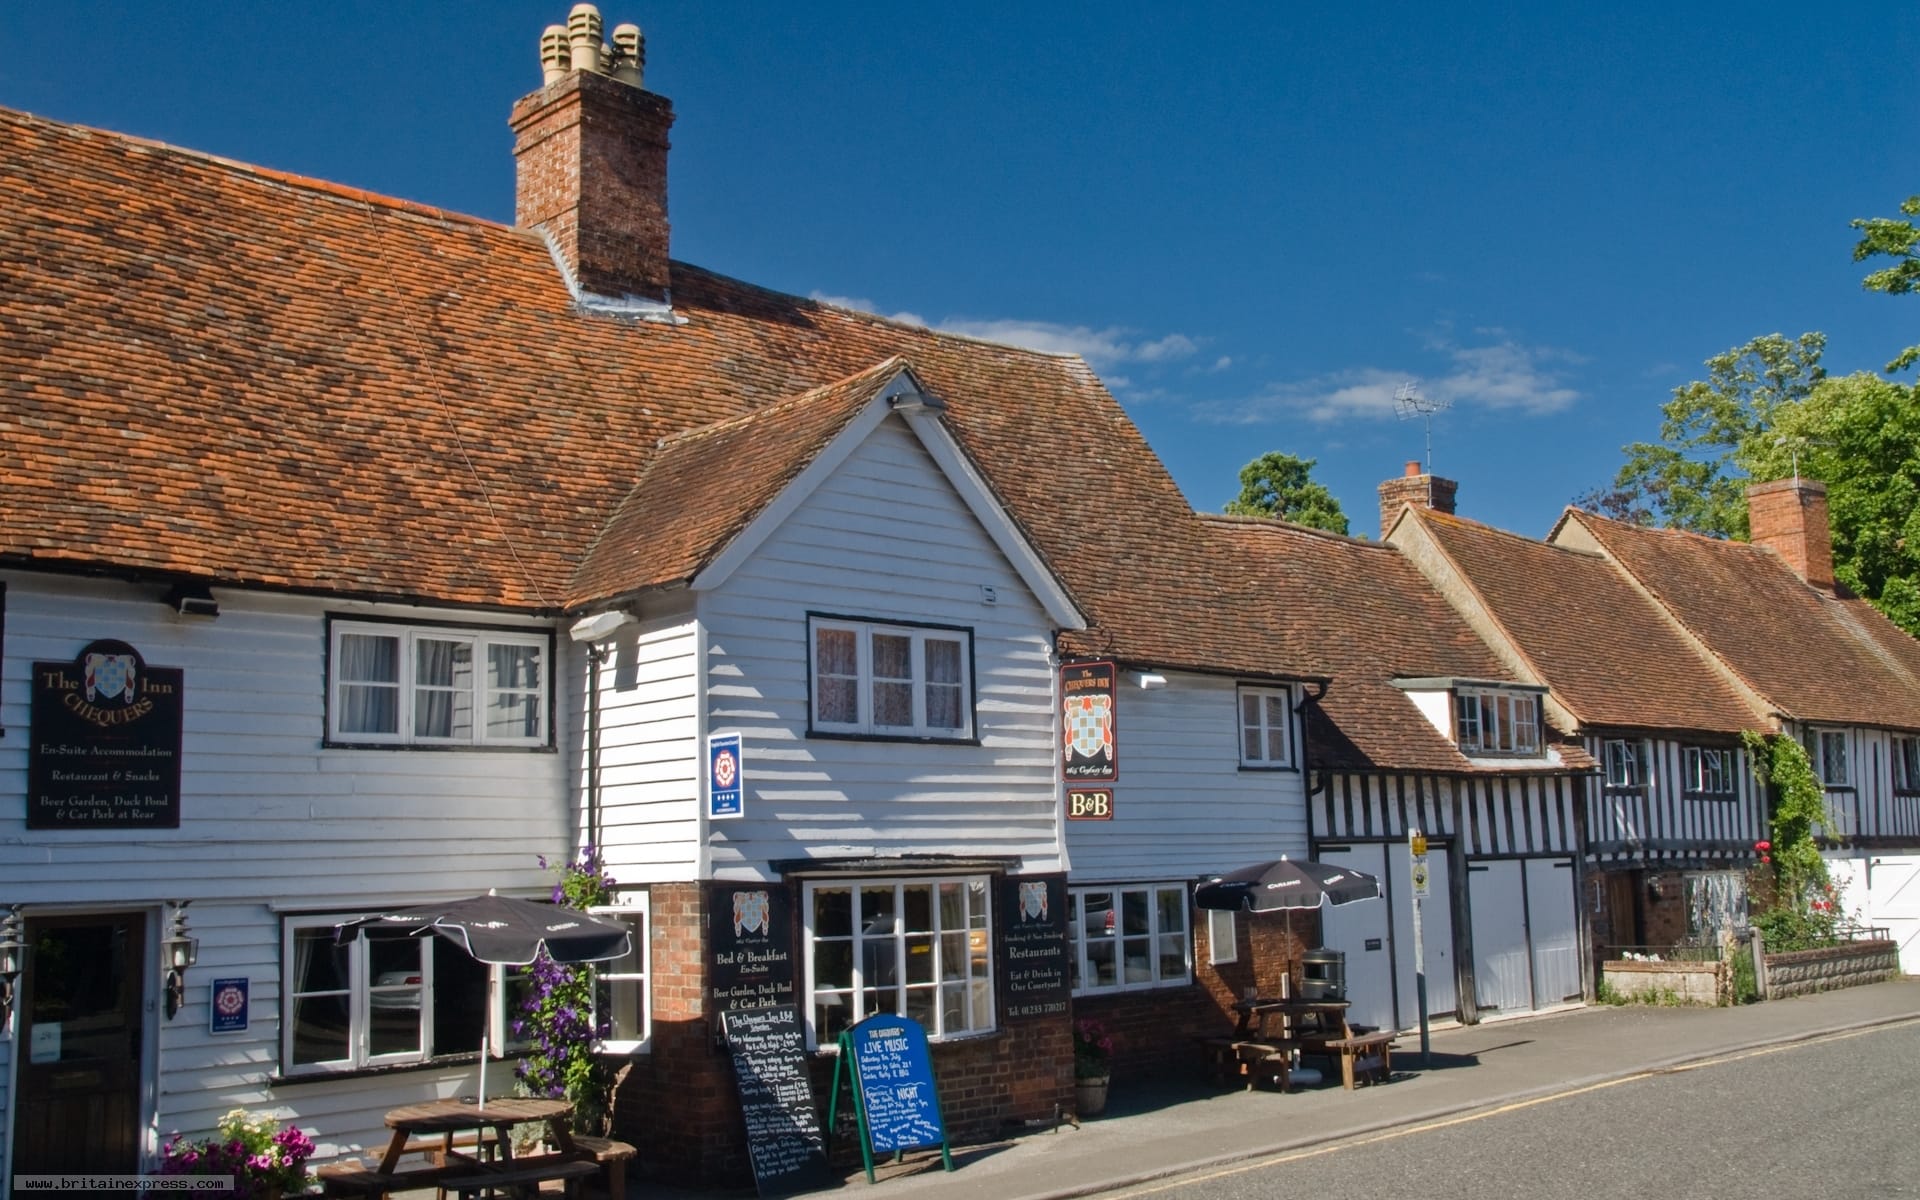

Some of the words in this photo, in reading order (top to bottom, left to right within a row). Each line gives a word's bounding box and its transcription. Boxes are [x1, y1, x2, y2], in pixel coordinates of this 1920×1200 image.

[42, 670, 79, 689] The
[1081, 670, 1092, 678] The
[142, 678, 173, 694] Inn
[64, 692, 153, 727] CHEQUERS
[40, 744, 87, 756] En-Suite
[90, 744, 172, 758] Accommodation
[52, 770, 108, 781] Restaurant
[112, 771, 120, 780] &
[125, 770, 160, 781] Snacks
[40, 796, 64, 806] Beer
[68, 794, 110, 808] Garden,
[114, 794, 142, 806] Duck
[145, 794, 168, 806] Pond
[56, 810, 66, 818] &
[69, 809, 89, 819] Car
[92, 808, 115, 819] Park
[118, 810, 128, 819] at
[132, 809, 155, 819] Rear
[716, 951, 734, 965] Bed
[736, 952, 744, 964] &
[748, 948, 788, 963] Breakfast
[1009, 946, 1061, 960] Restaurants
[740, 964, 768, 974] En-Suite
[1010, 971, 1022, 981] Eat
[1024, 970, 1030, 980] &
[1032, 968, 1052, 979] Drink
[1054, 969, 1062, 978] in
[713, 988, 729, 999] Beer
[730, 984, 757, 998] Garden,
[758, 982, 776, 994] Duck
[777, 980, 792, 994] Pond
[1010, 982, 1026, 992] Our
[1028, 978, 1061, 992] Courtyard
[730, 999, 738, 1010] &
[740, 998, 756, 1008] Car
[758, 995, 777, 1008] Park
[864, 1040, 883, 1054] LIVE
[884, 1038, 909, 1052] MUSIC
[896, 1086, 918, 1101] NIGHT
